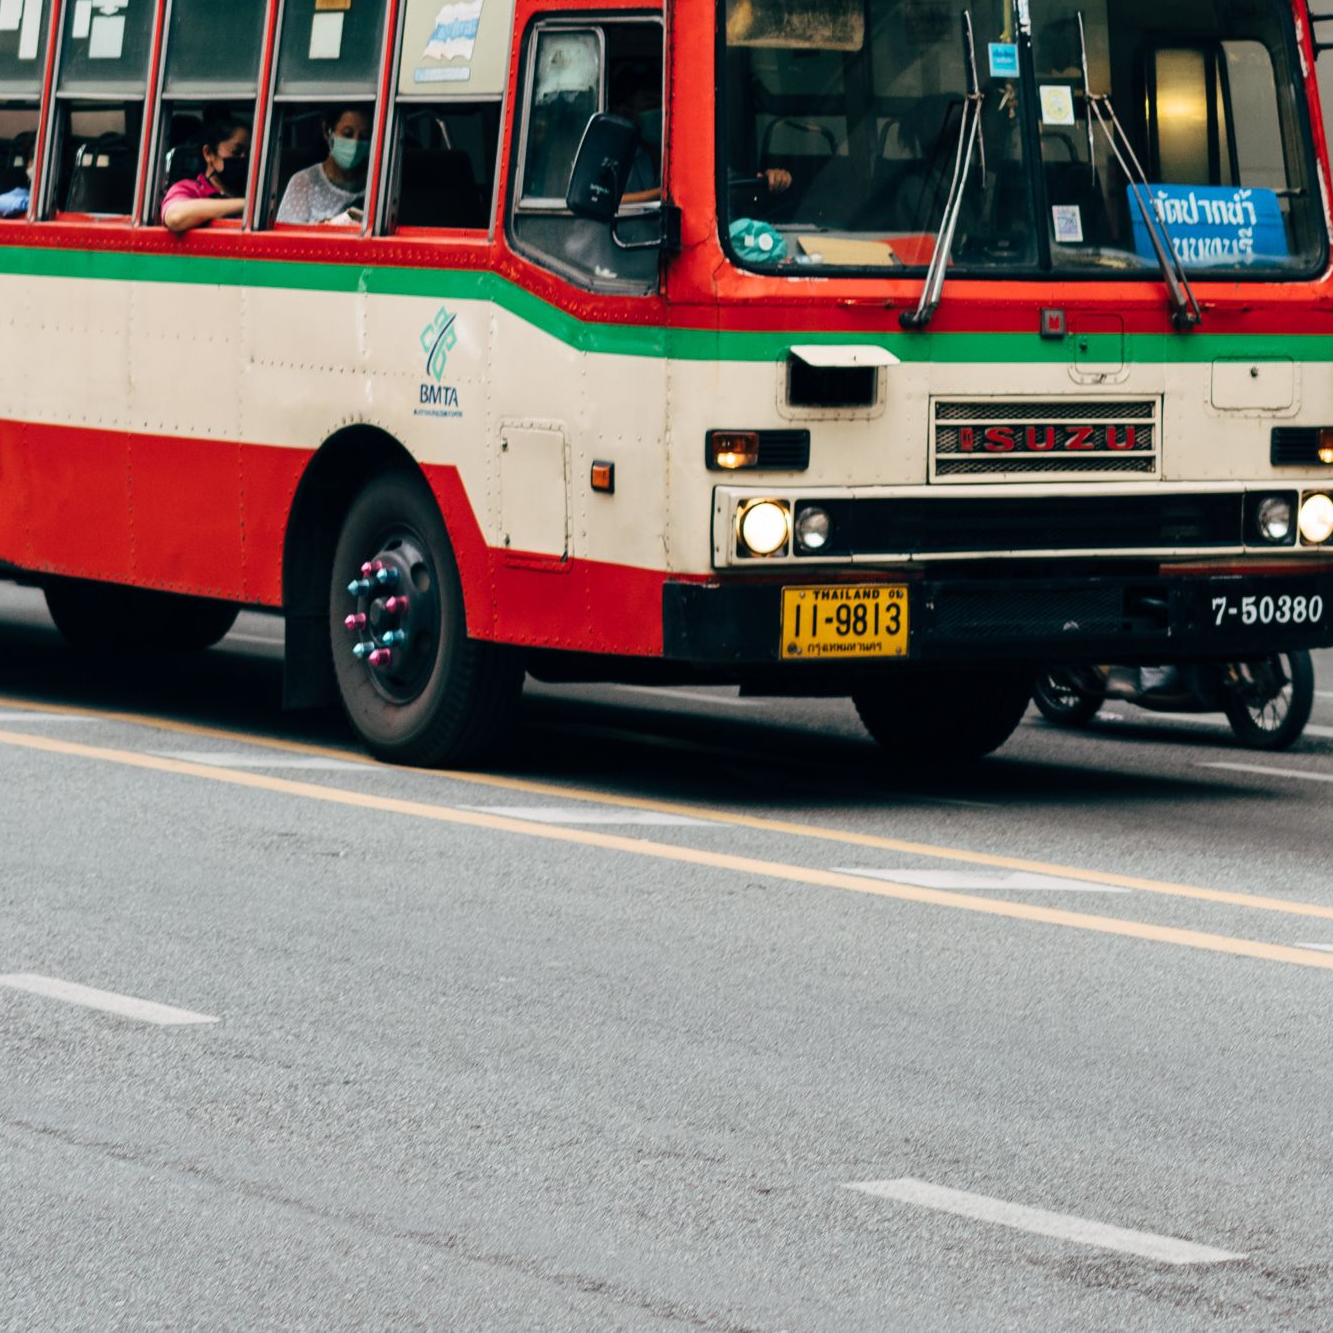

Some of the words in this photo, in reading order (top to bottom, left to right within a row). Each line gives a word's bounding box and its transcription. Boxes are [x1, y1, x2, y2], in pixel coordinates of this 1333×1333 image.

[419, 383, 459, 407] BMTA
[959, 426, 1136, 452] ISUZU
[813, 590, 880, 600] THAILAND
[794, 603, 901, 637] 11-9813
[1212, 595, 1323, 626] 7-50380
